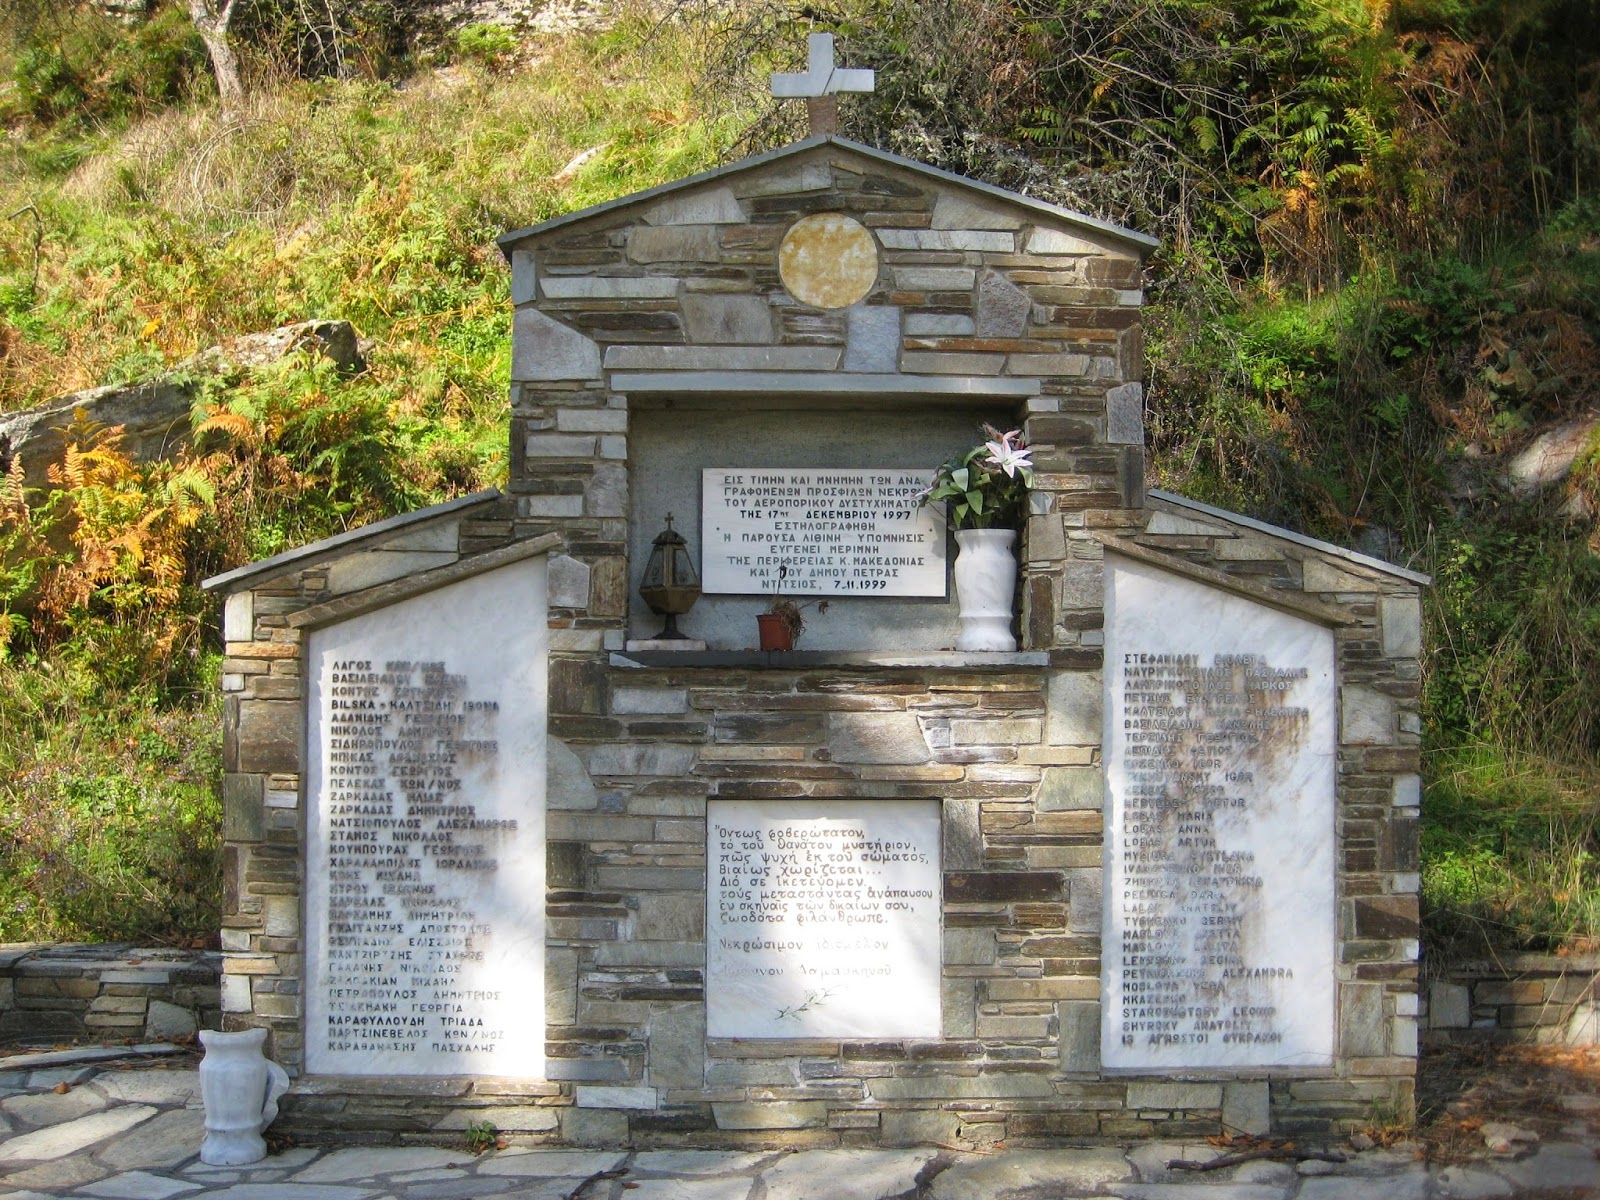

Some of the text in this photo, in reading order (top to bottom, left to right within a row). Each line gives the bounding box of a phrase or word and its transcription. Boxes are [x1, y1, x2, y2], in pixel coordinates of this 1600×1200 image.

[724, 475, 743, 484] ΕΙΣ
[750, 475, 785, 484] ΤΙΜΗΝ
[791, 476, 810, 484] ΚΑΙ
[816, 476, 863, 485] ΜΝΗΜΗΝ
[870, 476, 891, 485] ΤΩΝ
[724, 487, 801, 496] ΓΡΑΦΟΜΕΝΩΝ
[807, 488, 872, 497] ΠΡΟΣΦΙΛΩΝ
[724, 499, 925, 509] ΤΟΥ ΑΕΡΟΠΟΡΙΚΟΥ ΔΥΣΤΥΧΗΜΑΤΟ
[740, 510, 762, 519] ΤΗΣ
[806, 510, 877, 519] ΔΕΚΕΜΒΡΙΟΥ
[882, 511, 911, 520] 1997
[774, 522, 875, 531] ΕΣΤΗΛΟΓΡΑΦΗΘΗ
[723, 533, 925, 543] Η ΠΑΡΟΥΣΑ ΛΙΘΙΝΗ ΥΠΟΜΝΗΣΙΣ
[770, 545, 879, 554] ΕΥΓΕΝΕΙ ΜΕΡΙΜΝΗ
[727, 556, 751, 565] ΤΗΣ
[757, 556, 834, 565] ΠΕΡΙΦΕΡΕΙΑΣ
[749, 568, 899, 577] ΚΑΙ ΟΥ ΔΗΜΟΥ ΠΕΤΡΑΣ
[332, 660, 372, 671] ΛΑΓΟΣ
[331, 700, 375, 710] BILSKA
[330, 805, 393, 814] ΖΑΡΚΑΔΑΣ
[750, 878, 766, 886] σε
[328, 1016, 484, 1026] ΚΑΡΑΦΥΛΛΟΥΔΗ ΤΡΙΑΔΑ
